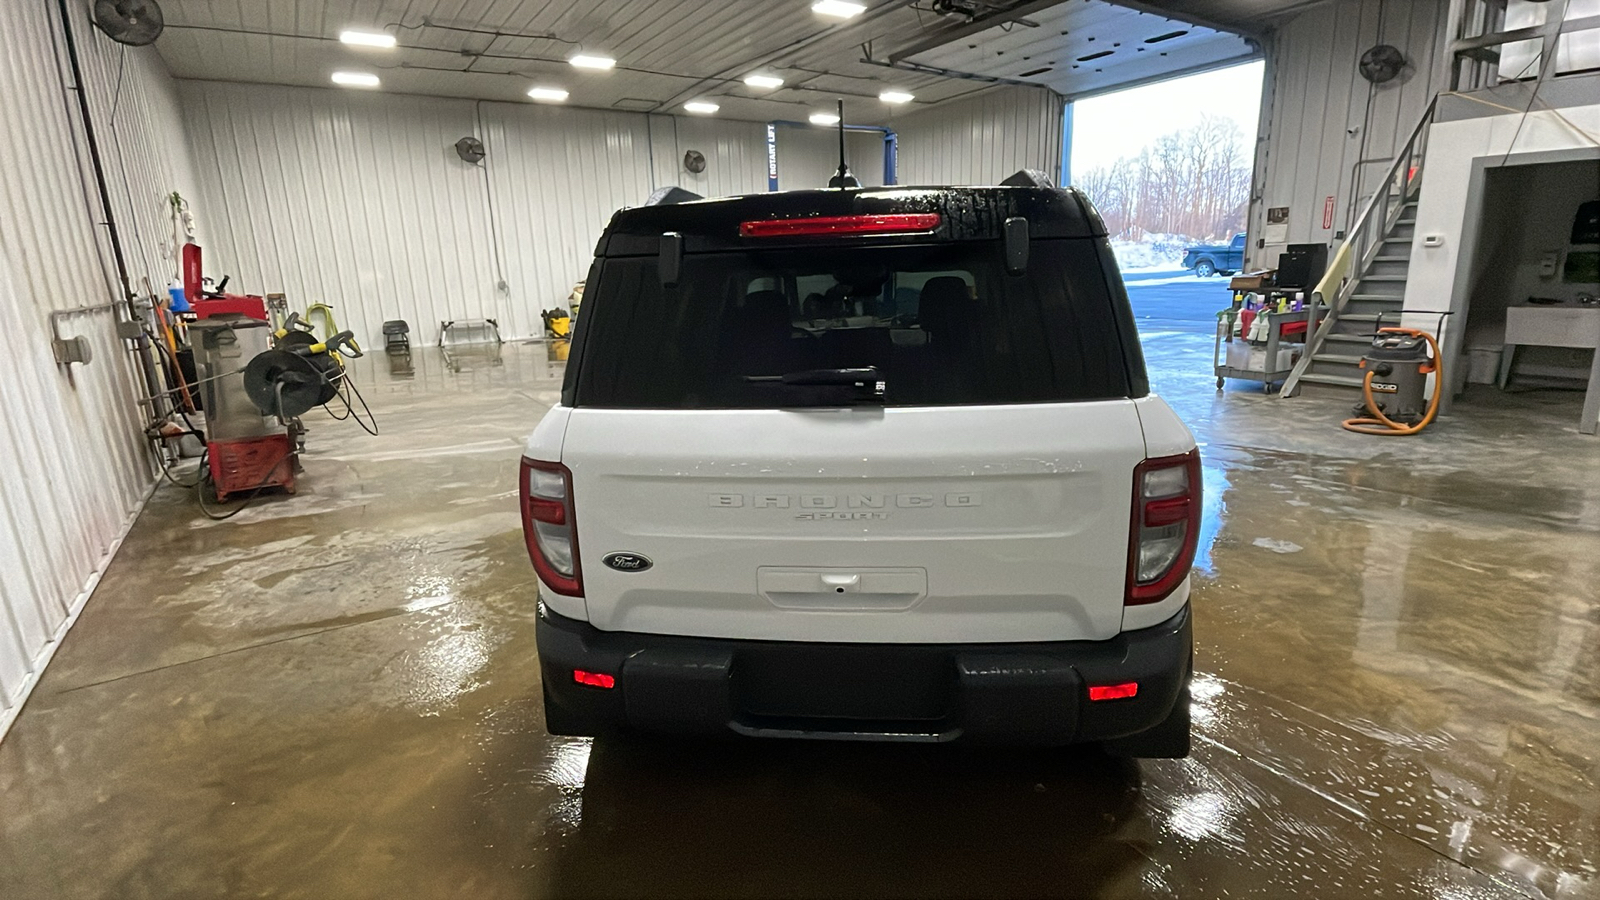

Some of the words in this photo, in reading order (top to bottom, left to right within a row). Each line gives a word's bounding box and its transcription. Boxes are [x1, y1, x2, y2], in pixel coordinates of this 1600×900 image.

[767, 124, 775, 142] LIFT
[708, 493, 983, 509] BRONCO
[795, 511, 890, 521] SPORT
[612, 555, 641, 569] Ford
